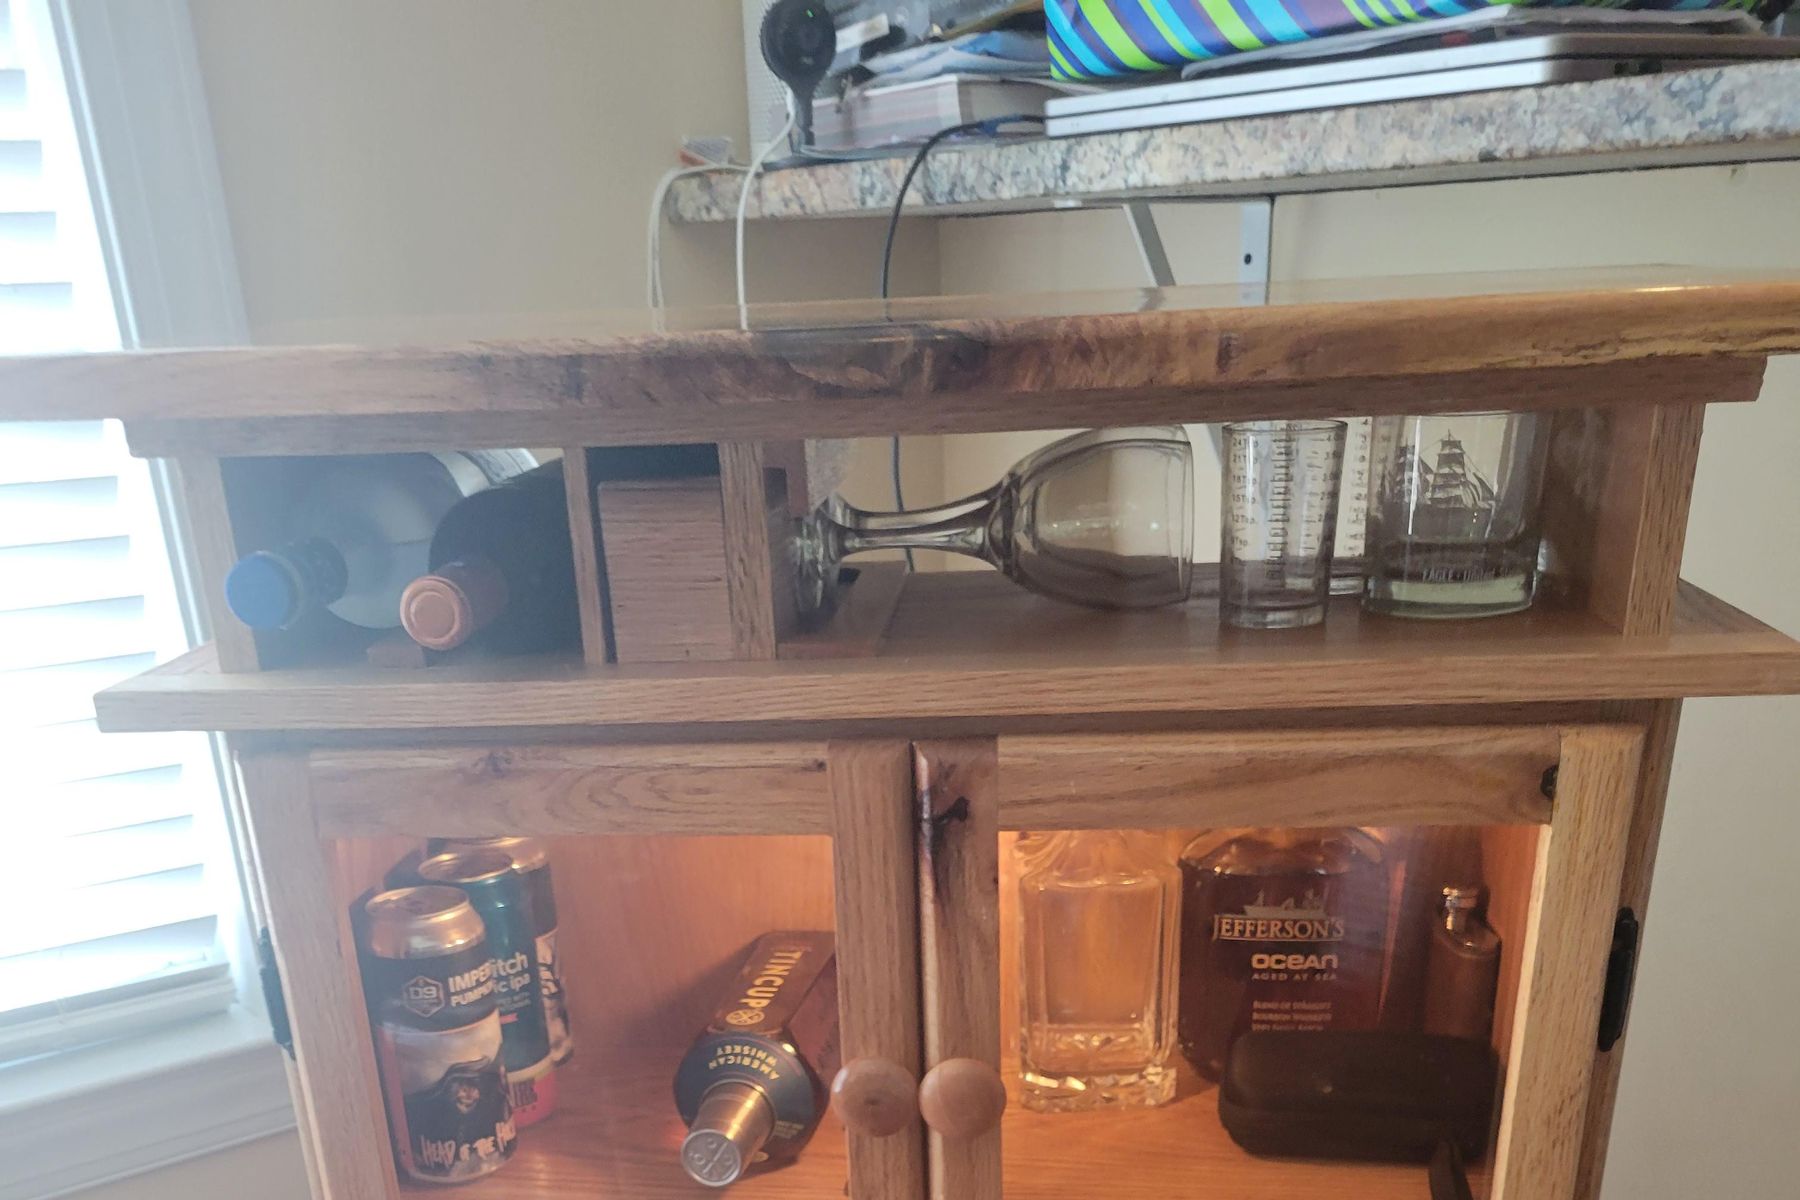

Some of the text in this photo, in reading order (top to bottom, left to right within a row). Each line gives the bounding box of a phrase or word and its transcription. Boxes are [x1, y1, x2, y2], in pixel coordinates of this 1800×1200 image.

[1212, 914, 1345, 941] JEFFERSON'S
[740, 950, 804, 1008] TINCUP
[708, 1055, 780, 1081] AMERICAN
[716, 1045, 778, 1067] WHISKEY
